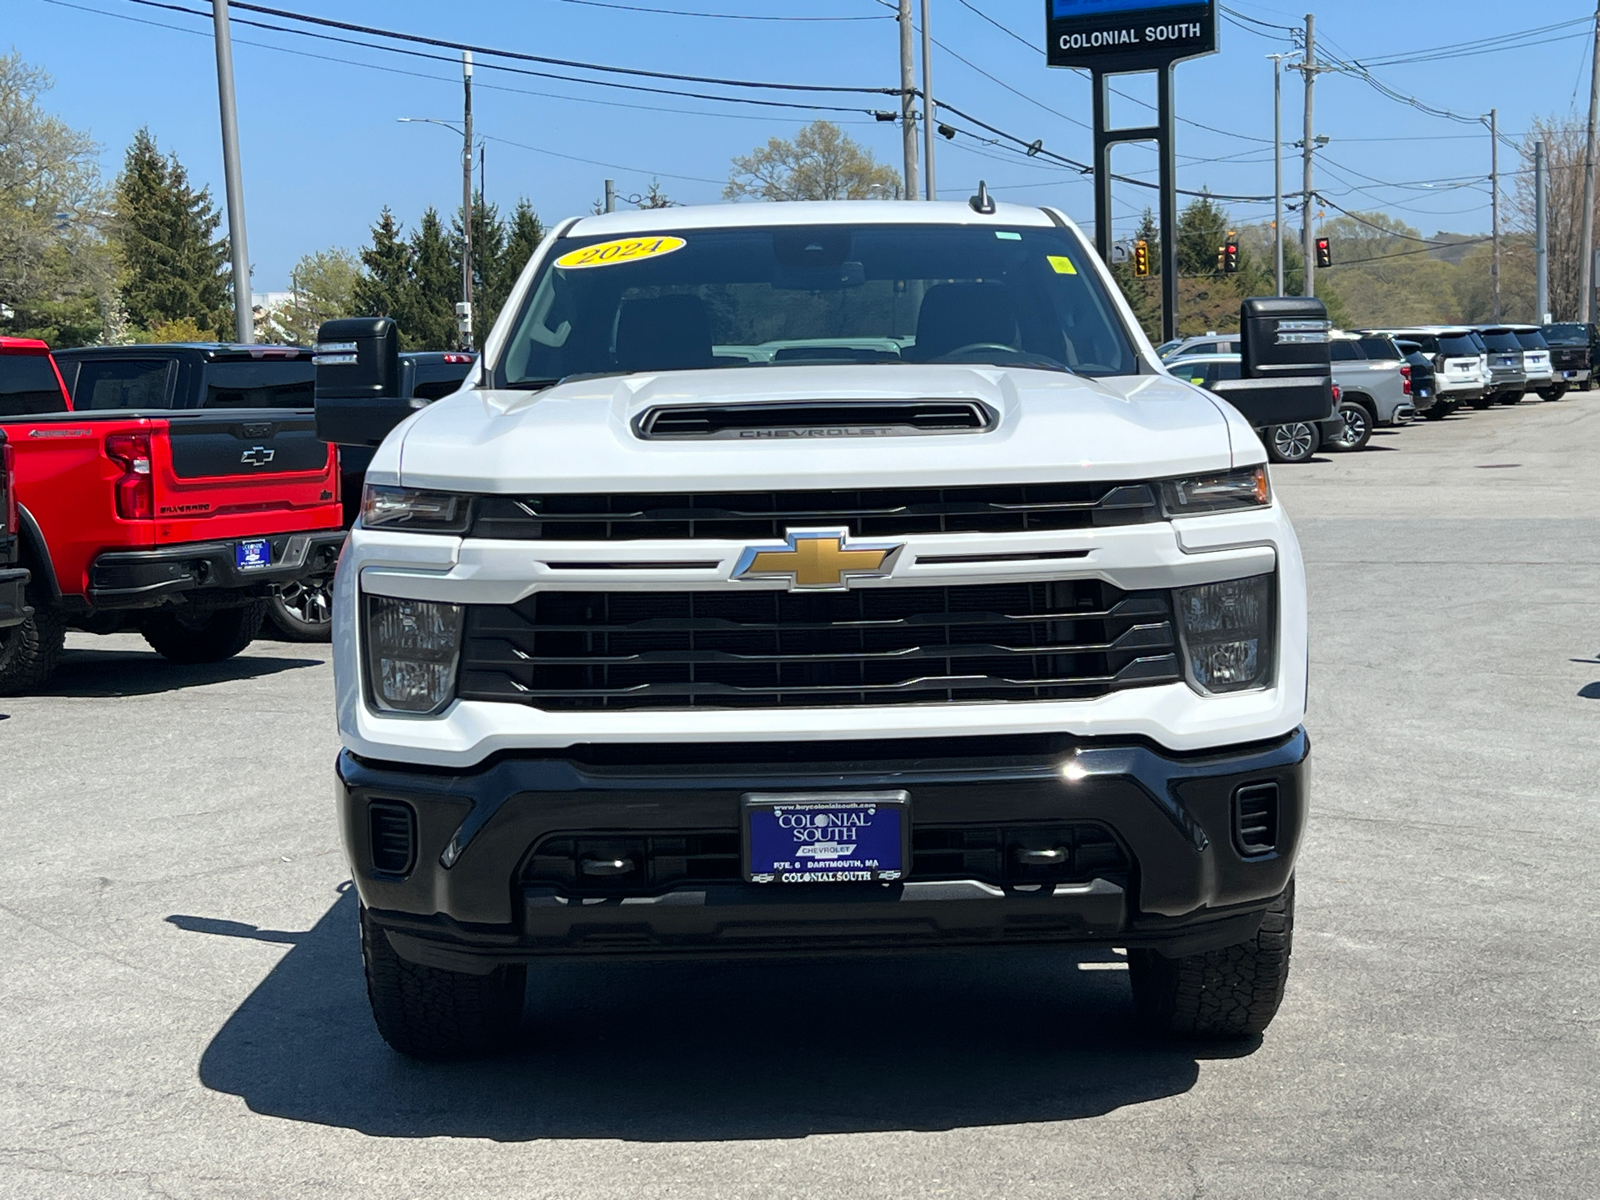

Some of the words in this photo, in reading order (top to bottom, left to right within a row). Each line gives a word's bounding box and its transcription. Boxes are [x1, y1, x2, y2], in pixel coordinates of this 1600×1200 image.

[1059, 28, 1140, 50] COLONIAL
[1145, 22, 1201, 42] SOUTH
[575, 239, 664, 265] 2024
[739, 428, 892, 438] CHEVROLET
[774, 803, 877, 811] www.buycolonialsouth.com
[779, 812, 872, 828] COLONIAL
[793, 827, 857, 842] SOUTH
[801, 846, 850, 855] CHEVROLET
[807, 860, 863, 868] DARTMOUTH,
[865, 859, 879, 867] MA
[782, 872, 835, 883] COLONIAL
[836, 871, 871, 881] SOUTH
